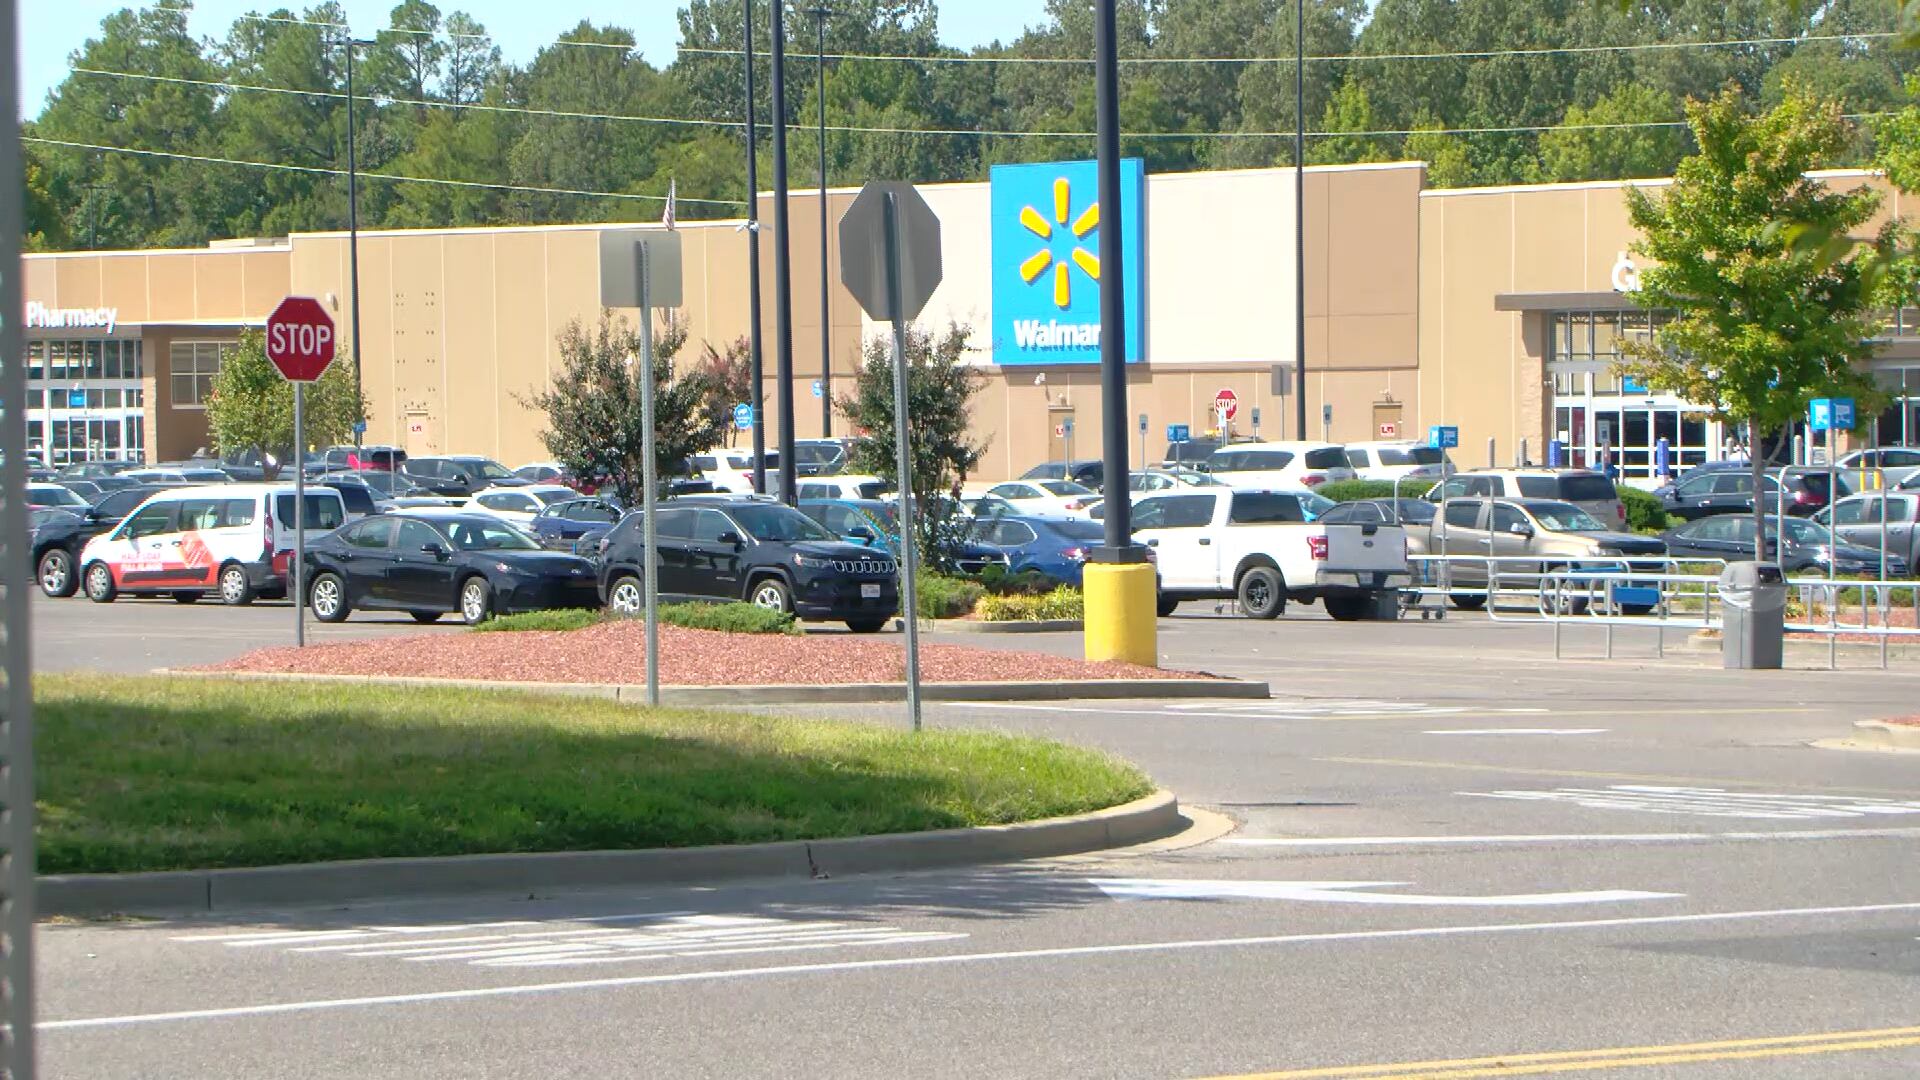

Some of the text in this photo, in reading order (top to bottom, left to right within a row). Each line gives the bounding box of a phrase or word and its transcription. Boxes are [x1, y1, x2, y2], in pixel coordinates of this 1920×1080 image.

[26, 301, 117, 334] Pharmacy
[271, 322, 331, 356] STOP
[1013, 319, 1101, 349] Walmar
[1216, 398, 1236, 411] STOP
